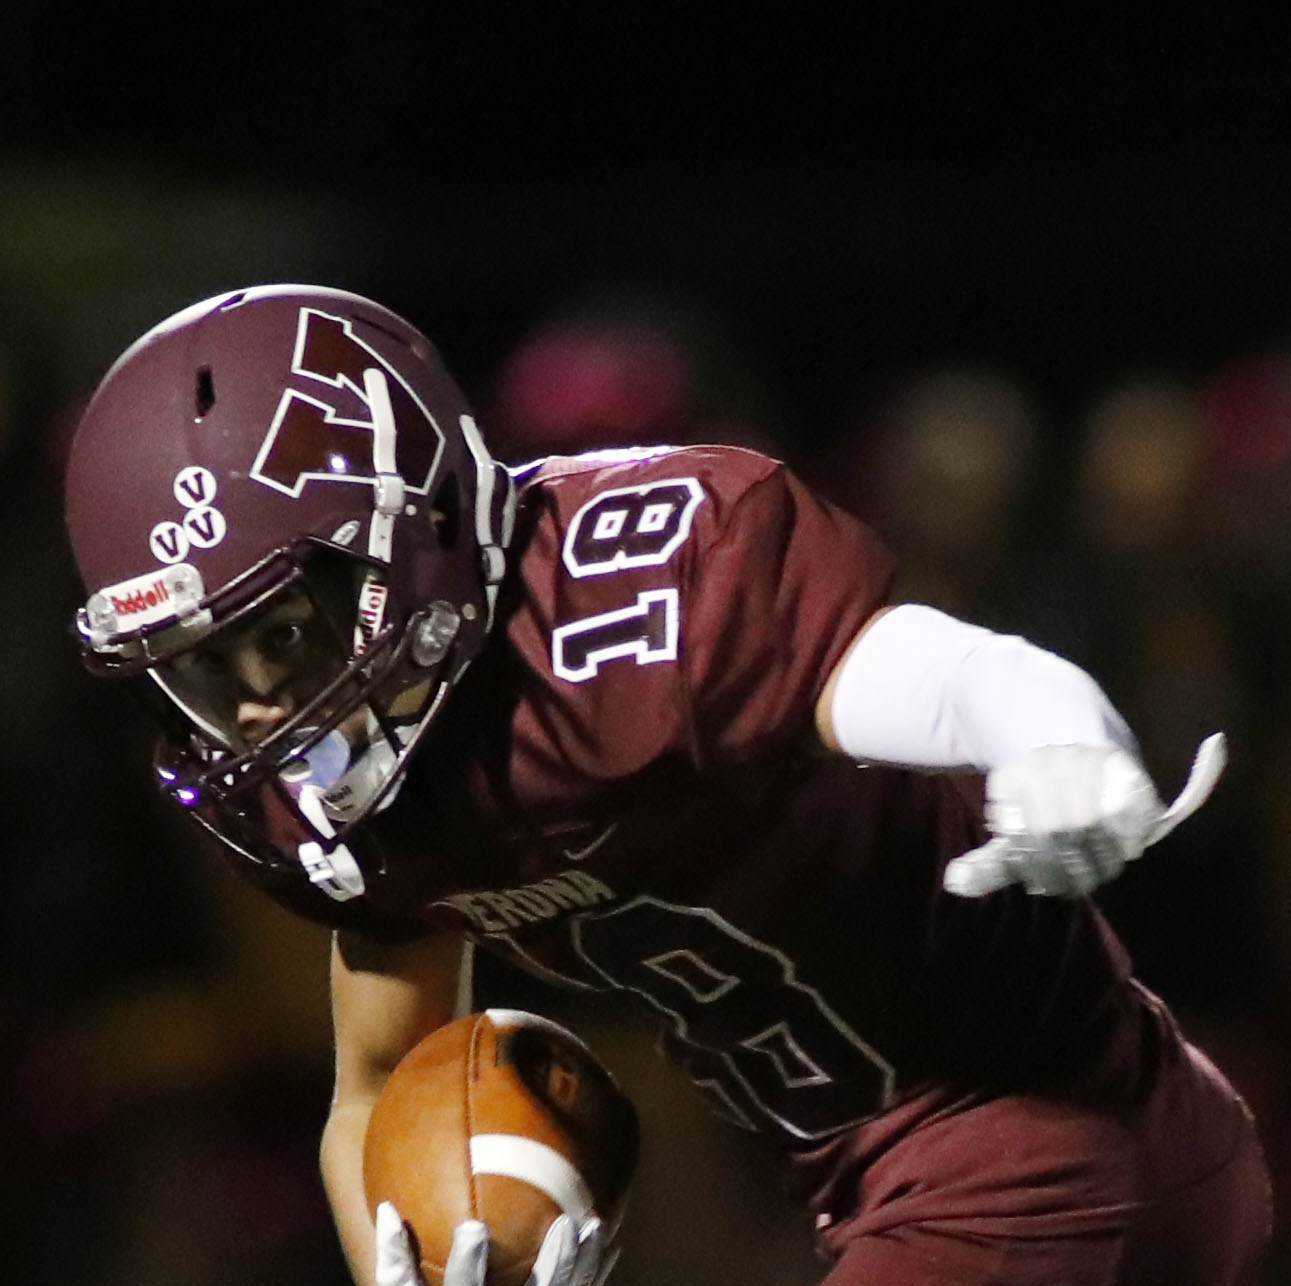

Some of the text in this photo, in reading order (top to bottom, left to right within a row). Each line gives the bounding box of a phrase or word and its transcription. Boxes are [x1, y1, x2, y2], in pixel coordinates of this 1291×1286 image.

[179, 472, 205, 503] V
[189, 511, 215, 542] V
[155, 528, 179, 558] V
[552, 476, 705, 683] 18
